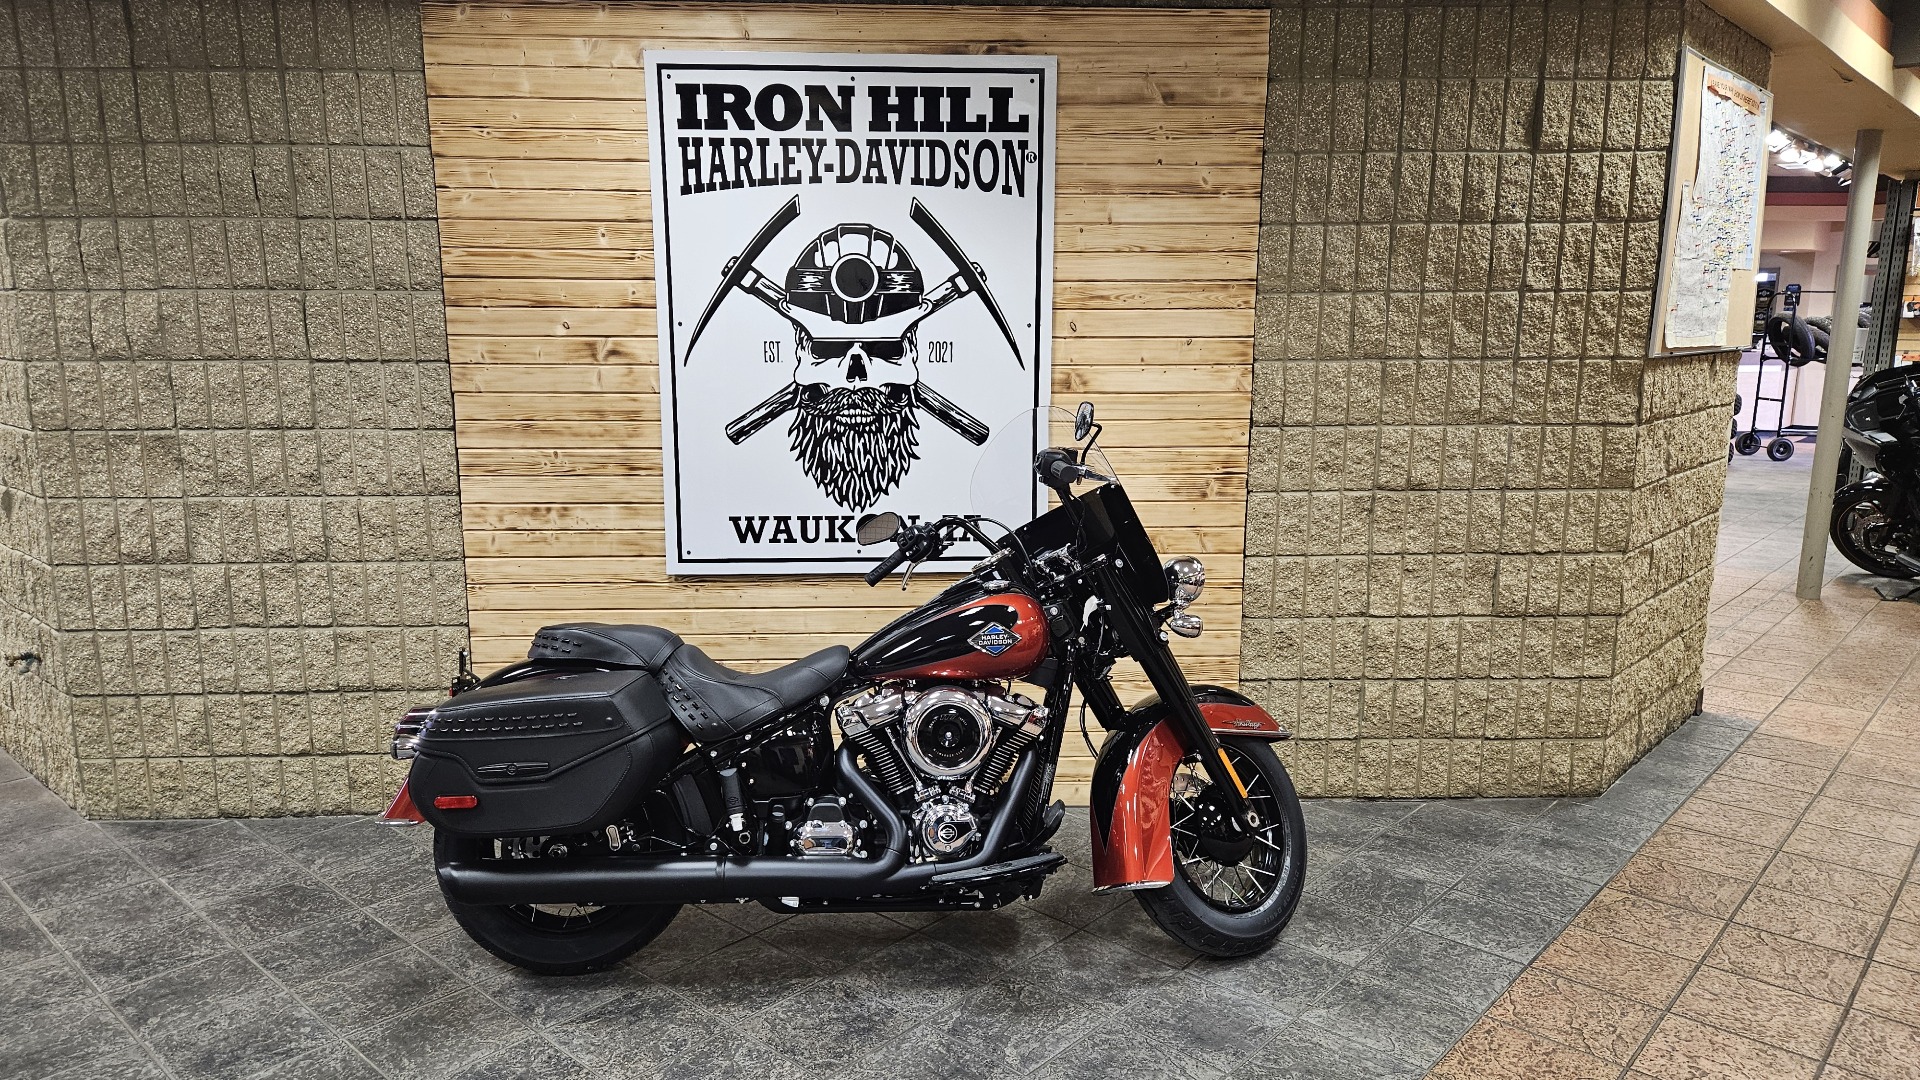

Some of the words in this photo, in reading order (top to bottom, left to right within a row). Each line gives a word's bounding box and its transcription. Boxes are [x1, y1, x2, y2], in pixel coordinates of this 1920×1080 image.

[675, 83, 855, 132] IRON
[867, 85, 1030, 133] HILL
[763, 341, 783, 363] EST.
[928, 341, 954, 363] 2021
[728, 514, 921, 544] WAUK
